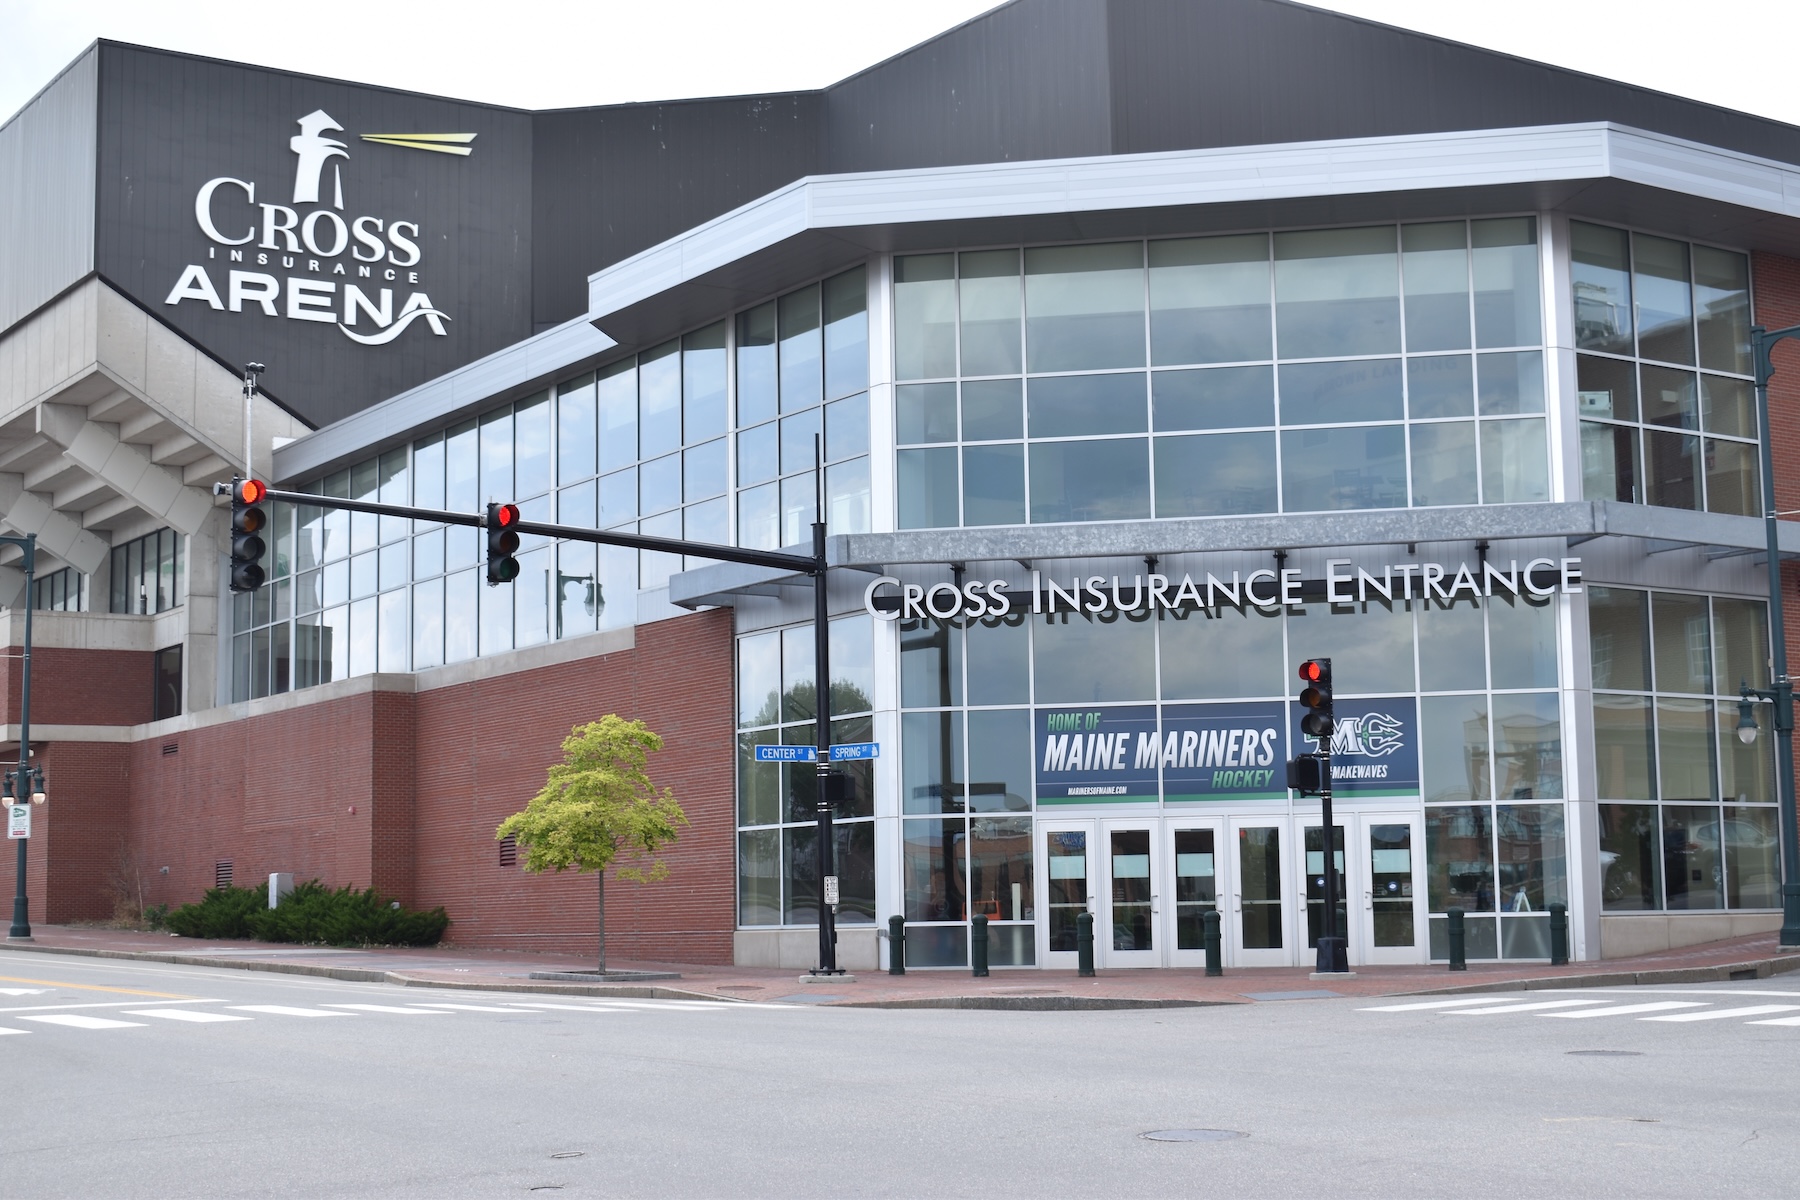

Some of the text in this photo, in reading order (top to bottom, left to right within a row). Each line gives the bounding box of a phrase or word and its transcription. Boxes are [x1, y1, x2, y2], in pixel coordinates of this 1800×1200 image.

[195, 176, 421, 267] CROSS
[209, 247, 418, 284] INSURANCE
[164, 264, 449, 337] ARENA
[864, 557, 1583, 621] CROSS INSURANCE ENTRANCE
[1047, 712, 1101, 732] HOME OF
[761, 748, 796, 759] CENTER
[835, 747, 861, 758] SPRING
[1043, 728, 1277, 772] MAINE MARINERS
[1067, 786, 1127, 795] MARINERSOFMAINE.COM
[1211, 769, 1274, 788] HOCKEY
